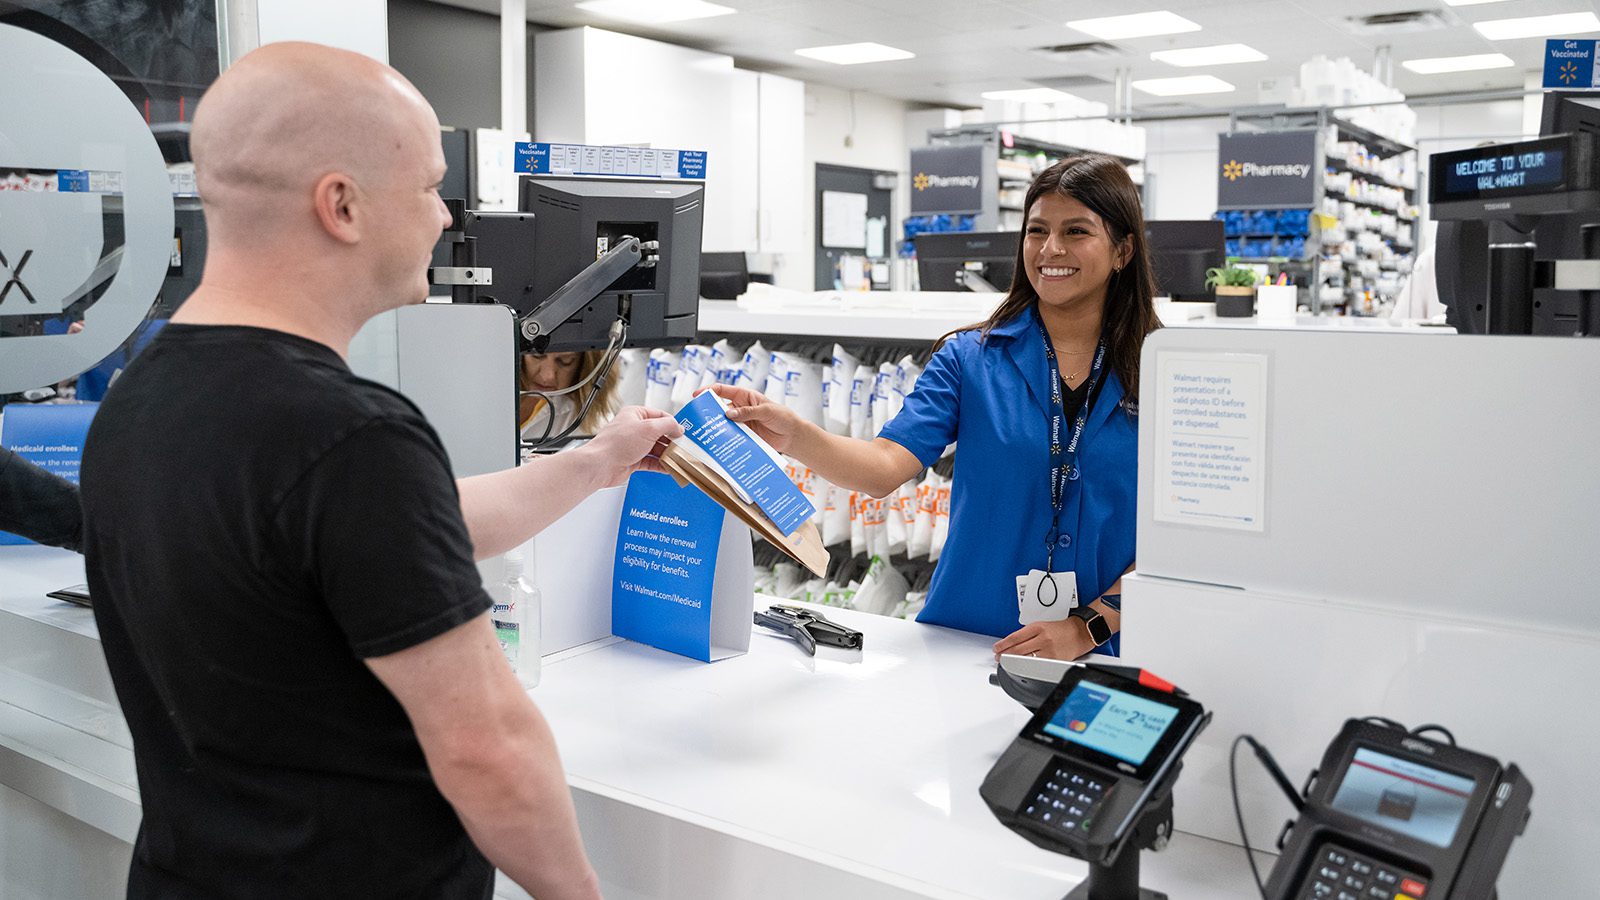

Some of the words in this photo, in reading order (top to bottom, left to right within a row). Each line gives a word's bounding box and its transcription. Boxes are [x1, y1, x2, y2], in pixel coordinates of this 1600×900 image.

[1551, 50, 1589, 58] Vaccinated
[1564, 41, 1578, 49] Get
[1242, 162, 1312, 179] Pharmacy
[1456, 158, 1496, 176] WELCOME
[1501, 157, 1514, 170] TO
[1519, 152, 1546, 168] YOUR
[928, 174, 979, 188] Pharmacy
[1051, 368, 1059, 394] Walmart
[1173, 374, 1201, 383] Walmart
[1203, 377, 1232, 385] requires
[1173, 385, 1216, 394] presentation
[1217, 387, 1225, 395] of
[1173, 396, 1189, 404] valid
[1190, 397, 1210, 406] photo
[1211, 398, 1221, 406] ID
[1221, 398, 1245, 407] before
[1173, 407, 1208, 417] controlled
[1209, 409, 1247, 419] substances
[1052, 415, 1060, 444] Walmart
[1067, 426, 1082, 453] Walmart
[1172, 440, 1196, 448] Walmart
[1051, 467, 1059, 497] Walmart
[630, 508, 659, 522] Medicaid
[659, 515, 689, 527] enrollees
[626, 526, 644, 537] Learn
[644, 529, 658, 540] how
[659, 533, 670, 543] the
[671, 538, 697, 549] renewal
[624, 541, 648, 554] process
[649, 547, 663, 558] may
[663, 549, 685, 562] impact
[686, 556, 702, 566] your
[623, 555, 650, 570] eligibility
[651, 560, 661, 570] for
[662, 563, 690, 578] benefits.
[620, 580, 634, 592] Visit
[634, 584, 701, 609] Walmart.com/Medicaid
[1108, 704, 1128, 715] Earn
[1147, 716, 1166, 724] cash
[1142, 721, 1161, 732] back
